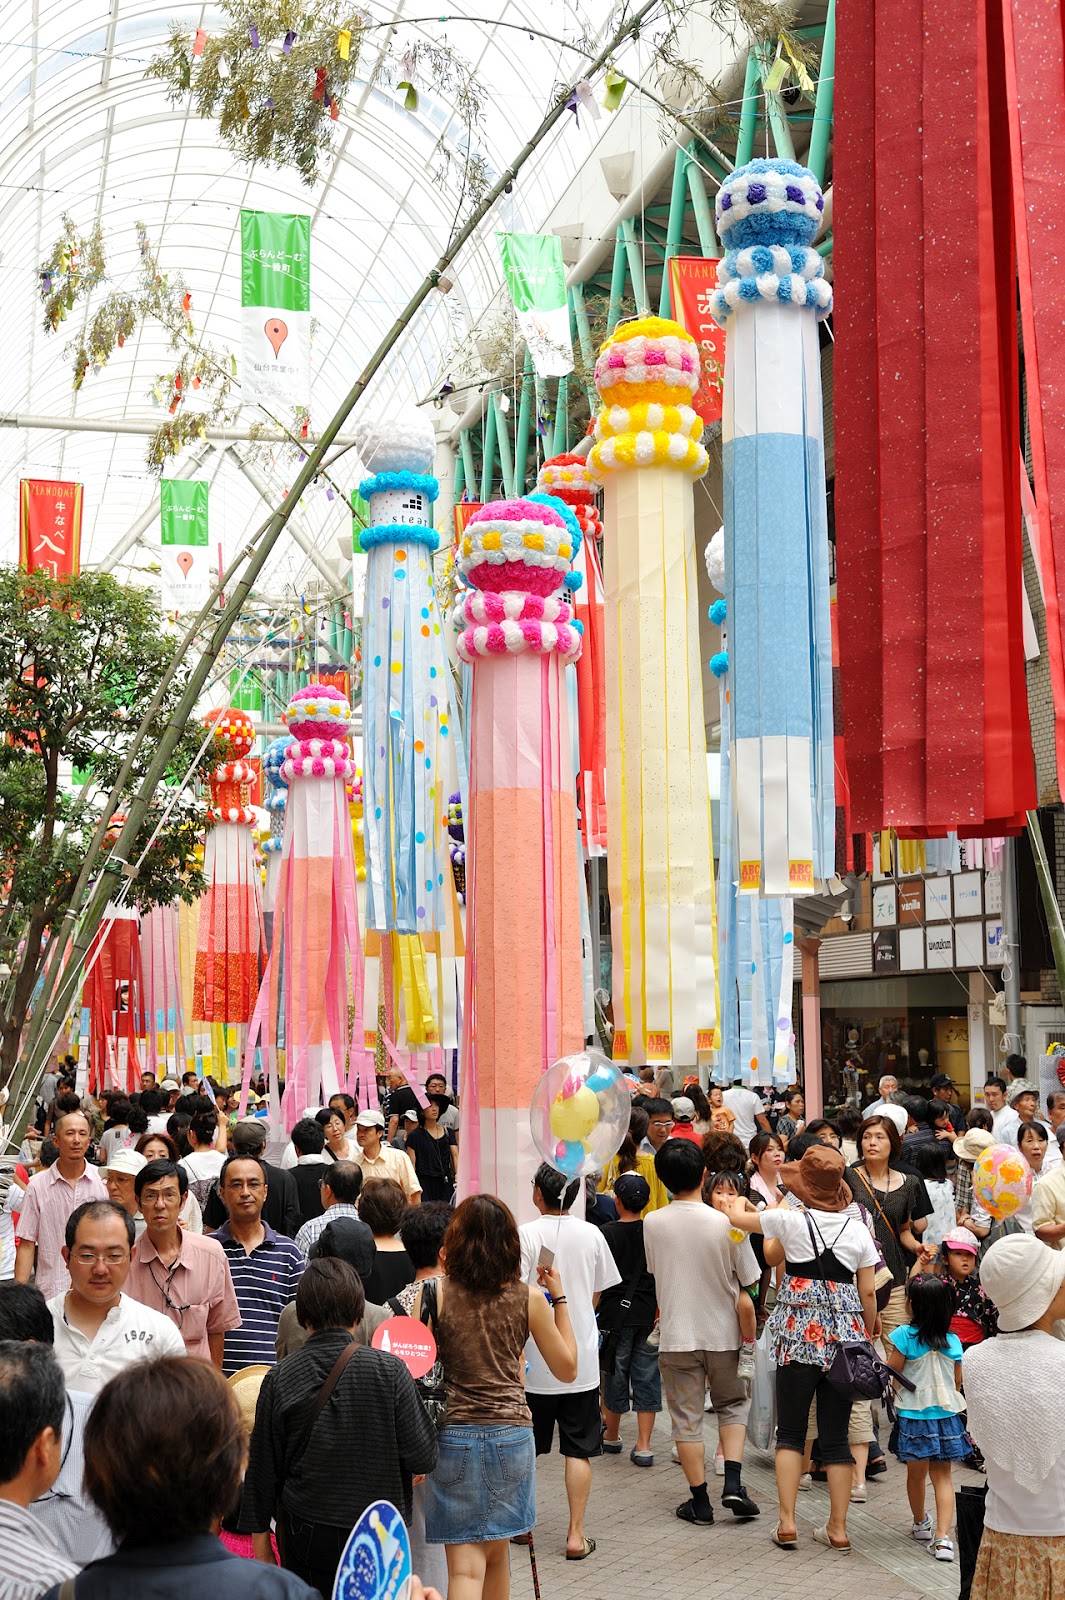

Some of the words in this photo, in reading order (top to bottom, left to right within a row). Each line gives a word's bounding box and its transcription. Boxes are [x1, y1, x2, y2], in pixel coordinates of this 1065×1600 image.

[249, 249, 303, 262] ぶらんどーむ
[261, 262, 291, 273] 一番町
[680, 264, 716, 279] VLAND
[54, 501, 66, 540] 牛なべ
[741, 864, 761, 876] ABC
[789, 863, 812, 875] ABC
[741, 875, 761, 883] MART
[789, 874, 812, 882] MART
[614, 1034, 627, 1045] AB
[648, 1034, 670, 1046] ABC
[648, 1045, 670, 1054] MART
[124, 1329, 154, 1345] 1902
[392, 1342, 431, 1351] がんばろう東北!
[394, 1350, 428, 1358] 心をひとつに。
